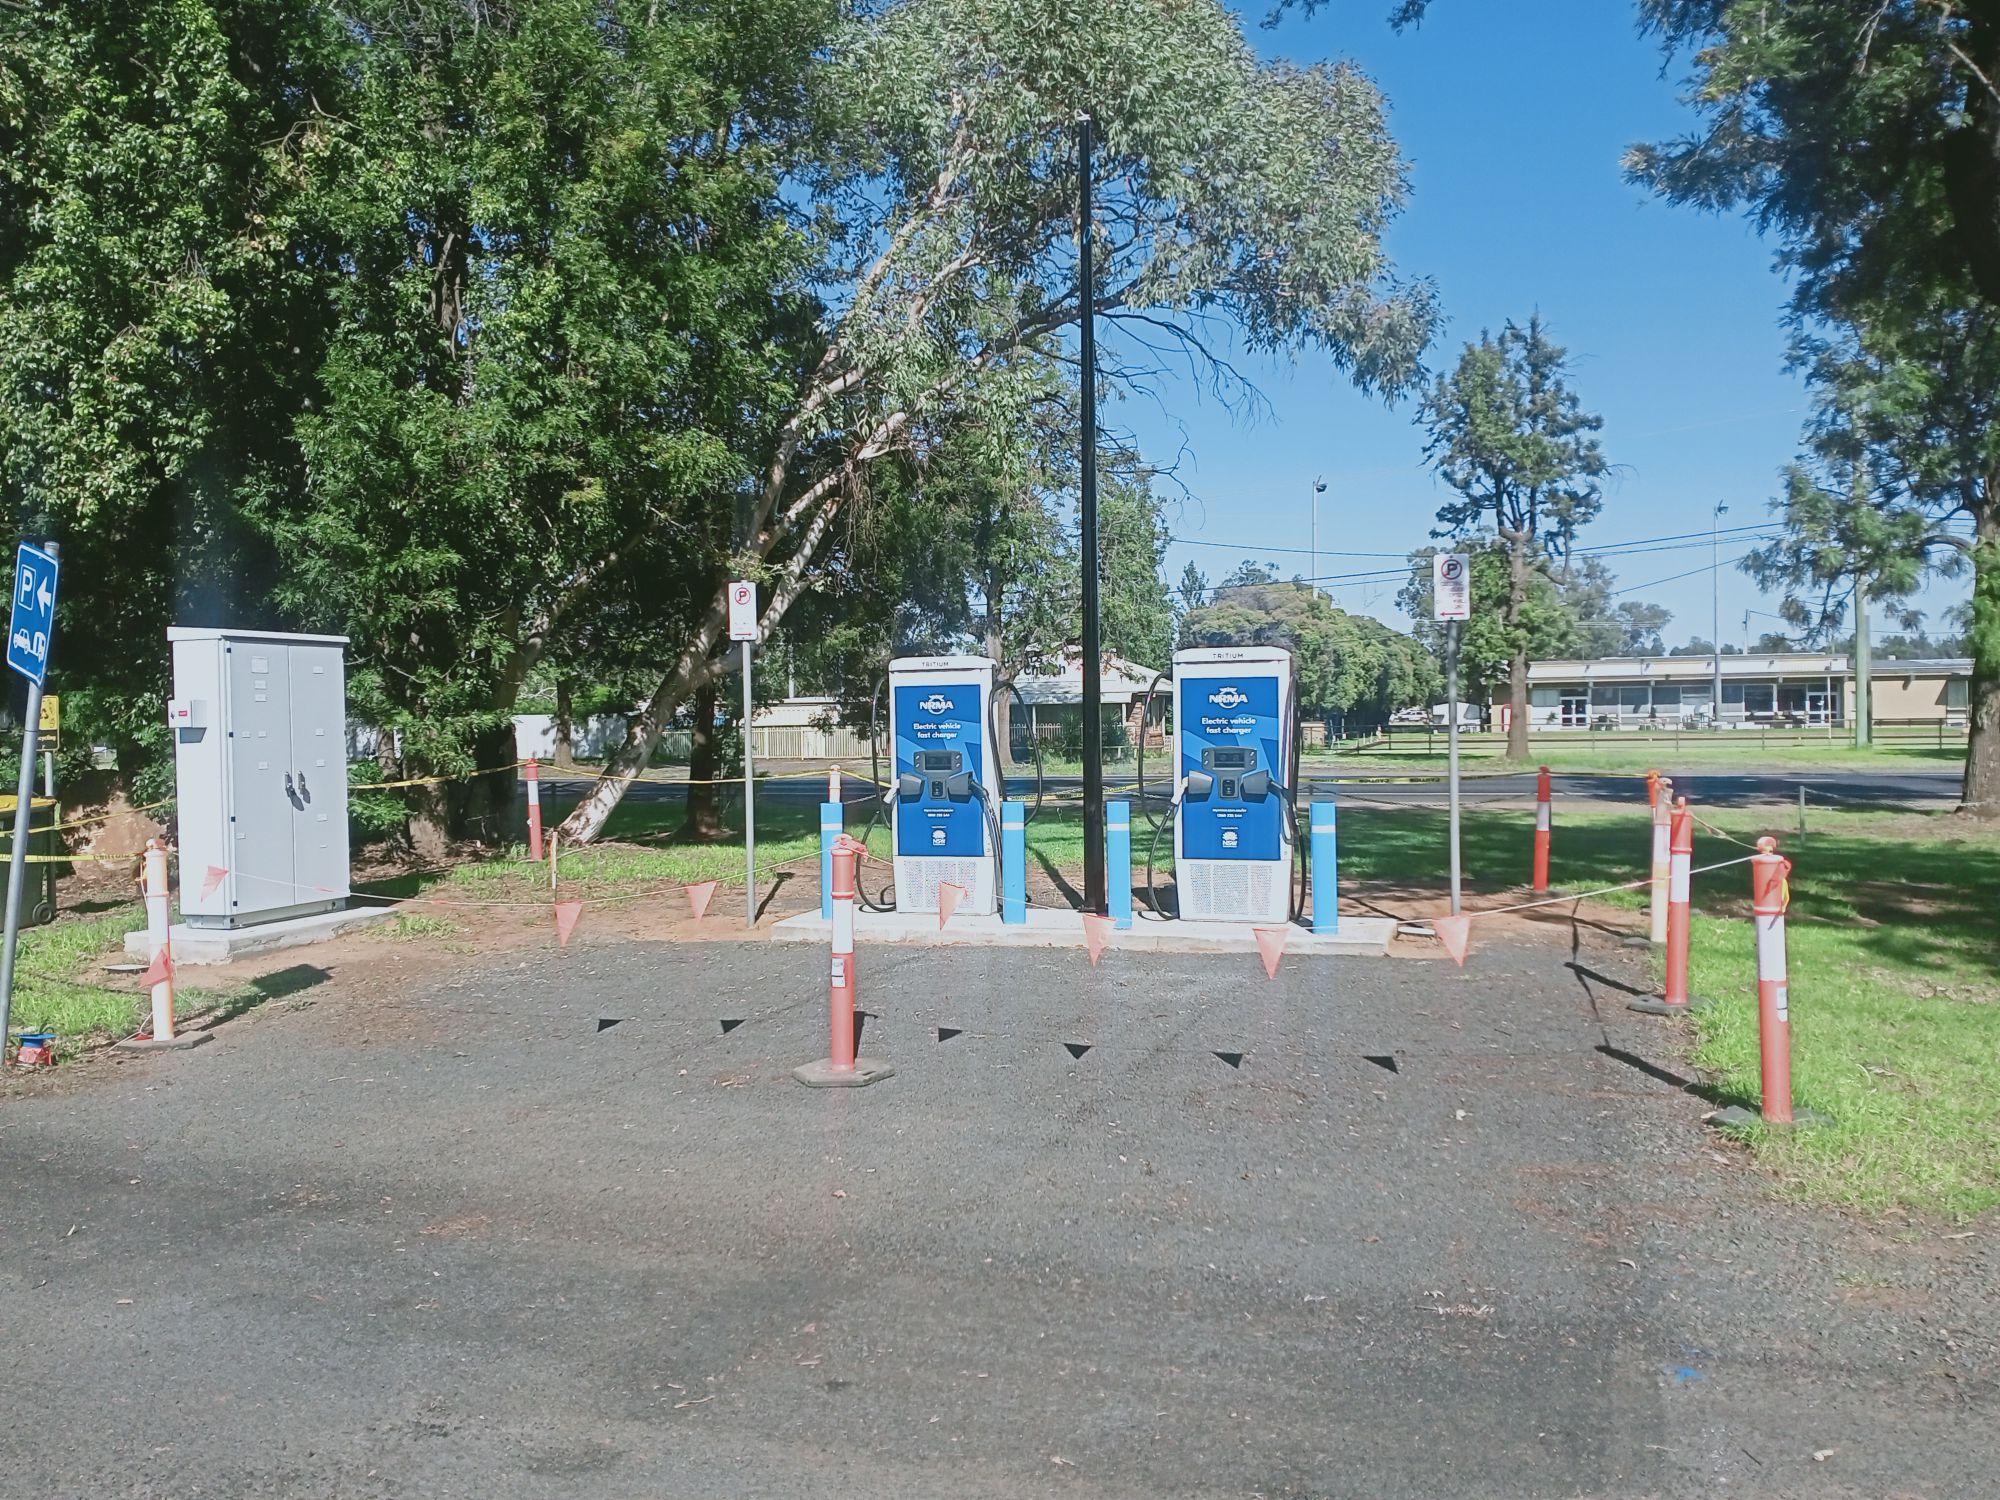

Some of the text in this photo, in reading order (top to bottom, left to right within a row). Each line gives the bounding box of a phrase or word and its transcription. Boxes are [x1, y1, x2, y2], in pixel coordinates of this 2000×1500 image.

[1447, 563, 1458, 576] P
[21, 568, 33, 603] P
[739, 590, 748, 602] P
[1208, 694, 1249, 704] NRMA
[919, 700, 954, 710] NRMA
[913, 722, 961, 730] Electric vehicle
[1201, 717, 1256, 725] Electric vehicle
[917, 731, 957, 740] fast charger
[1206, 726, 1252, 736] fast charger
